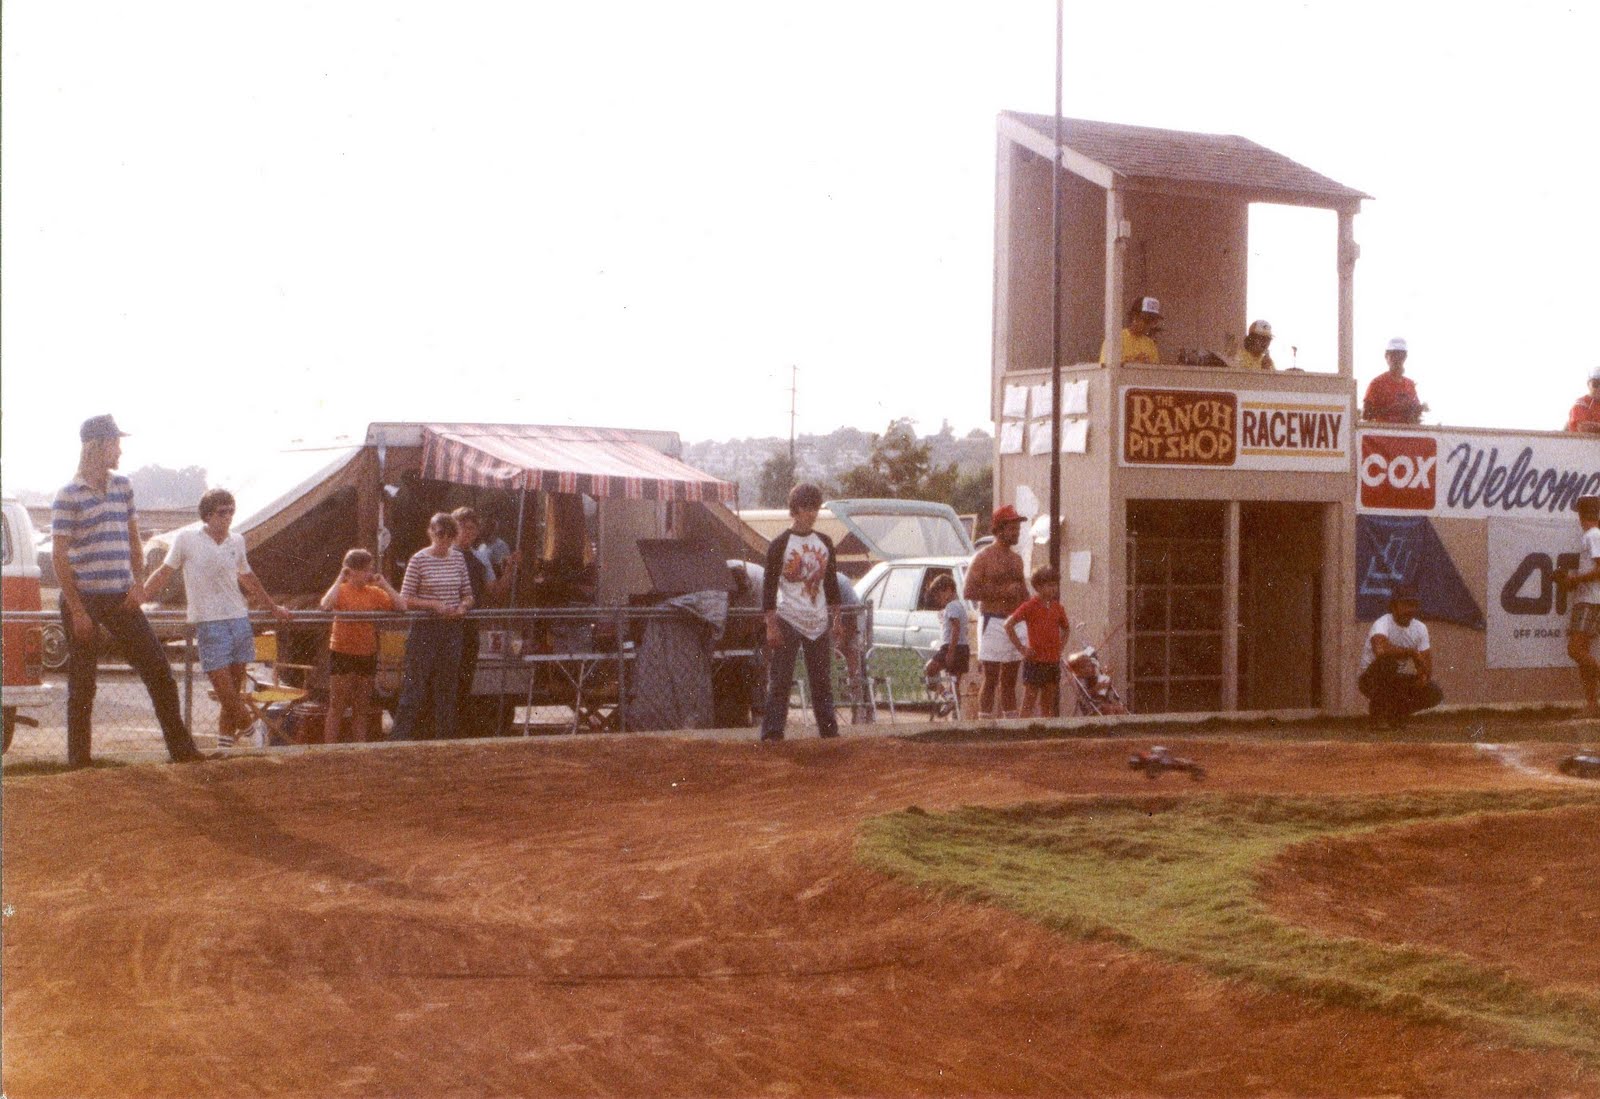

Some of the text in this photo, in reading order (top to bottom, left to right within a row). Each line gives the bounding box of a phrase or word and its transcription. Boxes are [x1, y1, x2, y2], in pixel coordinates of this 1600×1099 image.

[1130, 395, 1232, 435] RANCH
[1242, 410, 1342, 449] RACEWAY
[1361, 453, 1437, 489] COX
[1513, 628, 1561, 639] OFF ROAD
